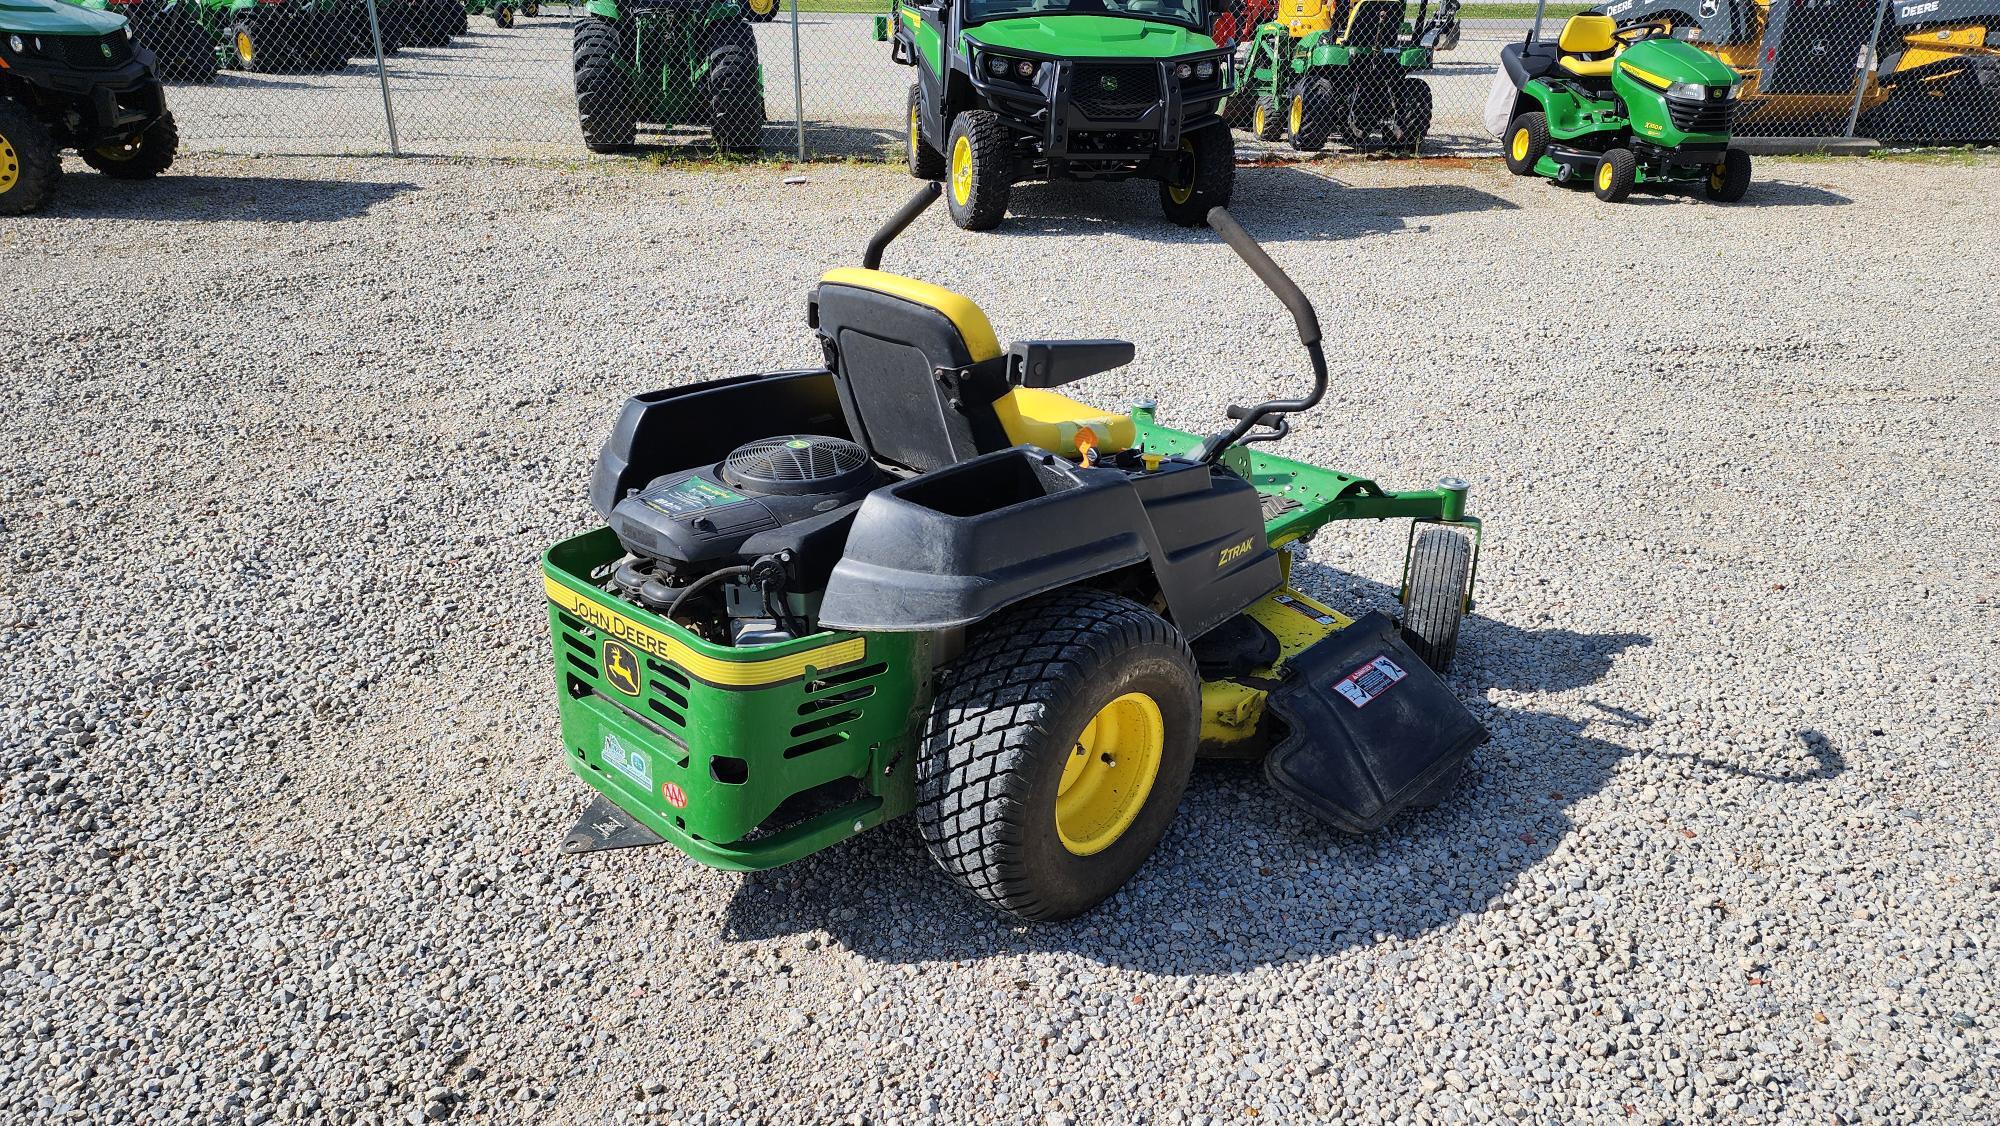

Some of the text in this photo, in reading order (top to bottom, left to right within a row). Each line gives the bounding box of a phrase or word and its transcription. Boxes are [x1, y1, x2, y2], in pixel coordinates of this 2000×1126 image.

[1606, 0, 1632, 16] DEERE
[1902, 1, 1939, 18] DEERE
[1218, 536, 1254, 567] ZTRAK
[571, 596, 668, 657] JOHN DEERE
